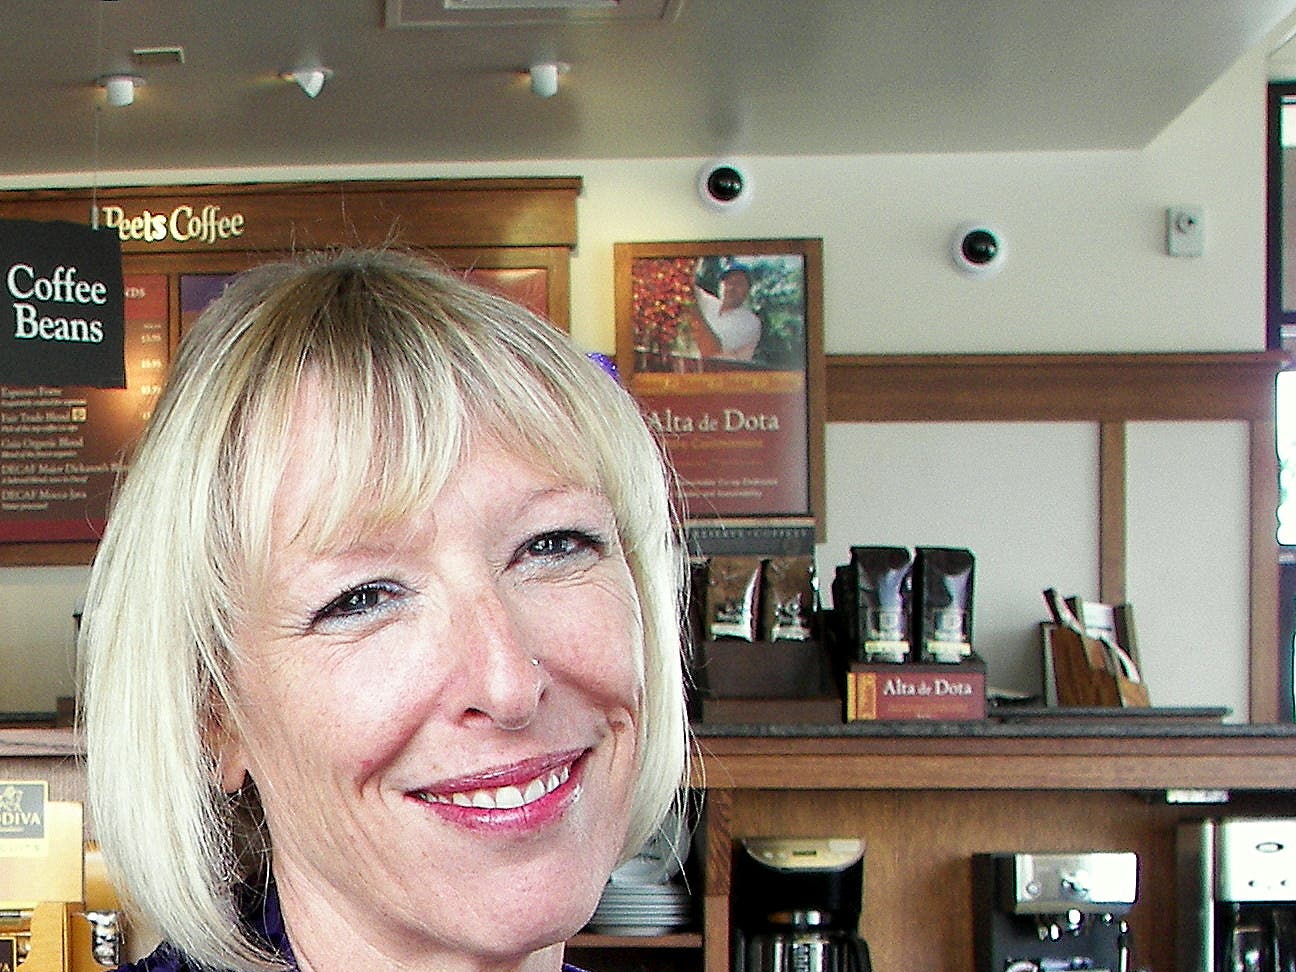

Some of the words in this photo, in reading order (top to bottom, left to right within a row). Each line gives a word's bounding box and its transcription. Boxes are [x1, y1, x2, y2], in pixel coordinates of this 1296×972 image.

[170, 205, 245, 244] Coffee
[7, 264, 107, 305] Coffee
[14, 302, 104, 343] Beans
[647, 409, 694, 433] Alta
[698, 413, 717, 432] de
[723, 409, 779, 433] Dota
[883, 677, 915, 696] Alta
[917, 682, 932, 697] de
[934, 679, 972, 696] Dota
